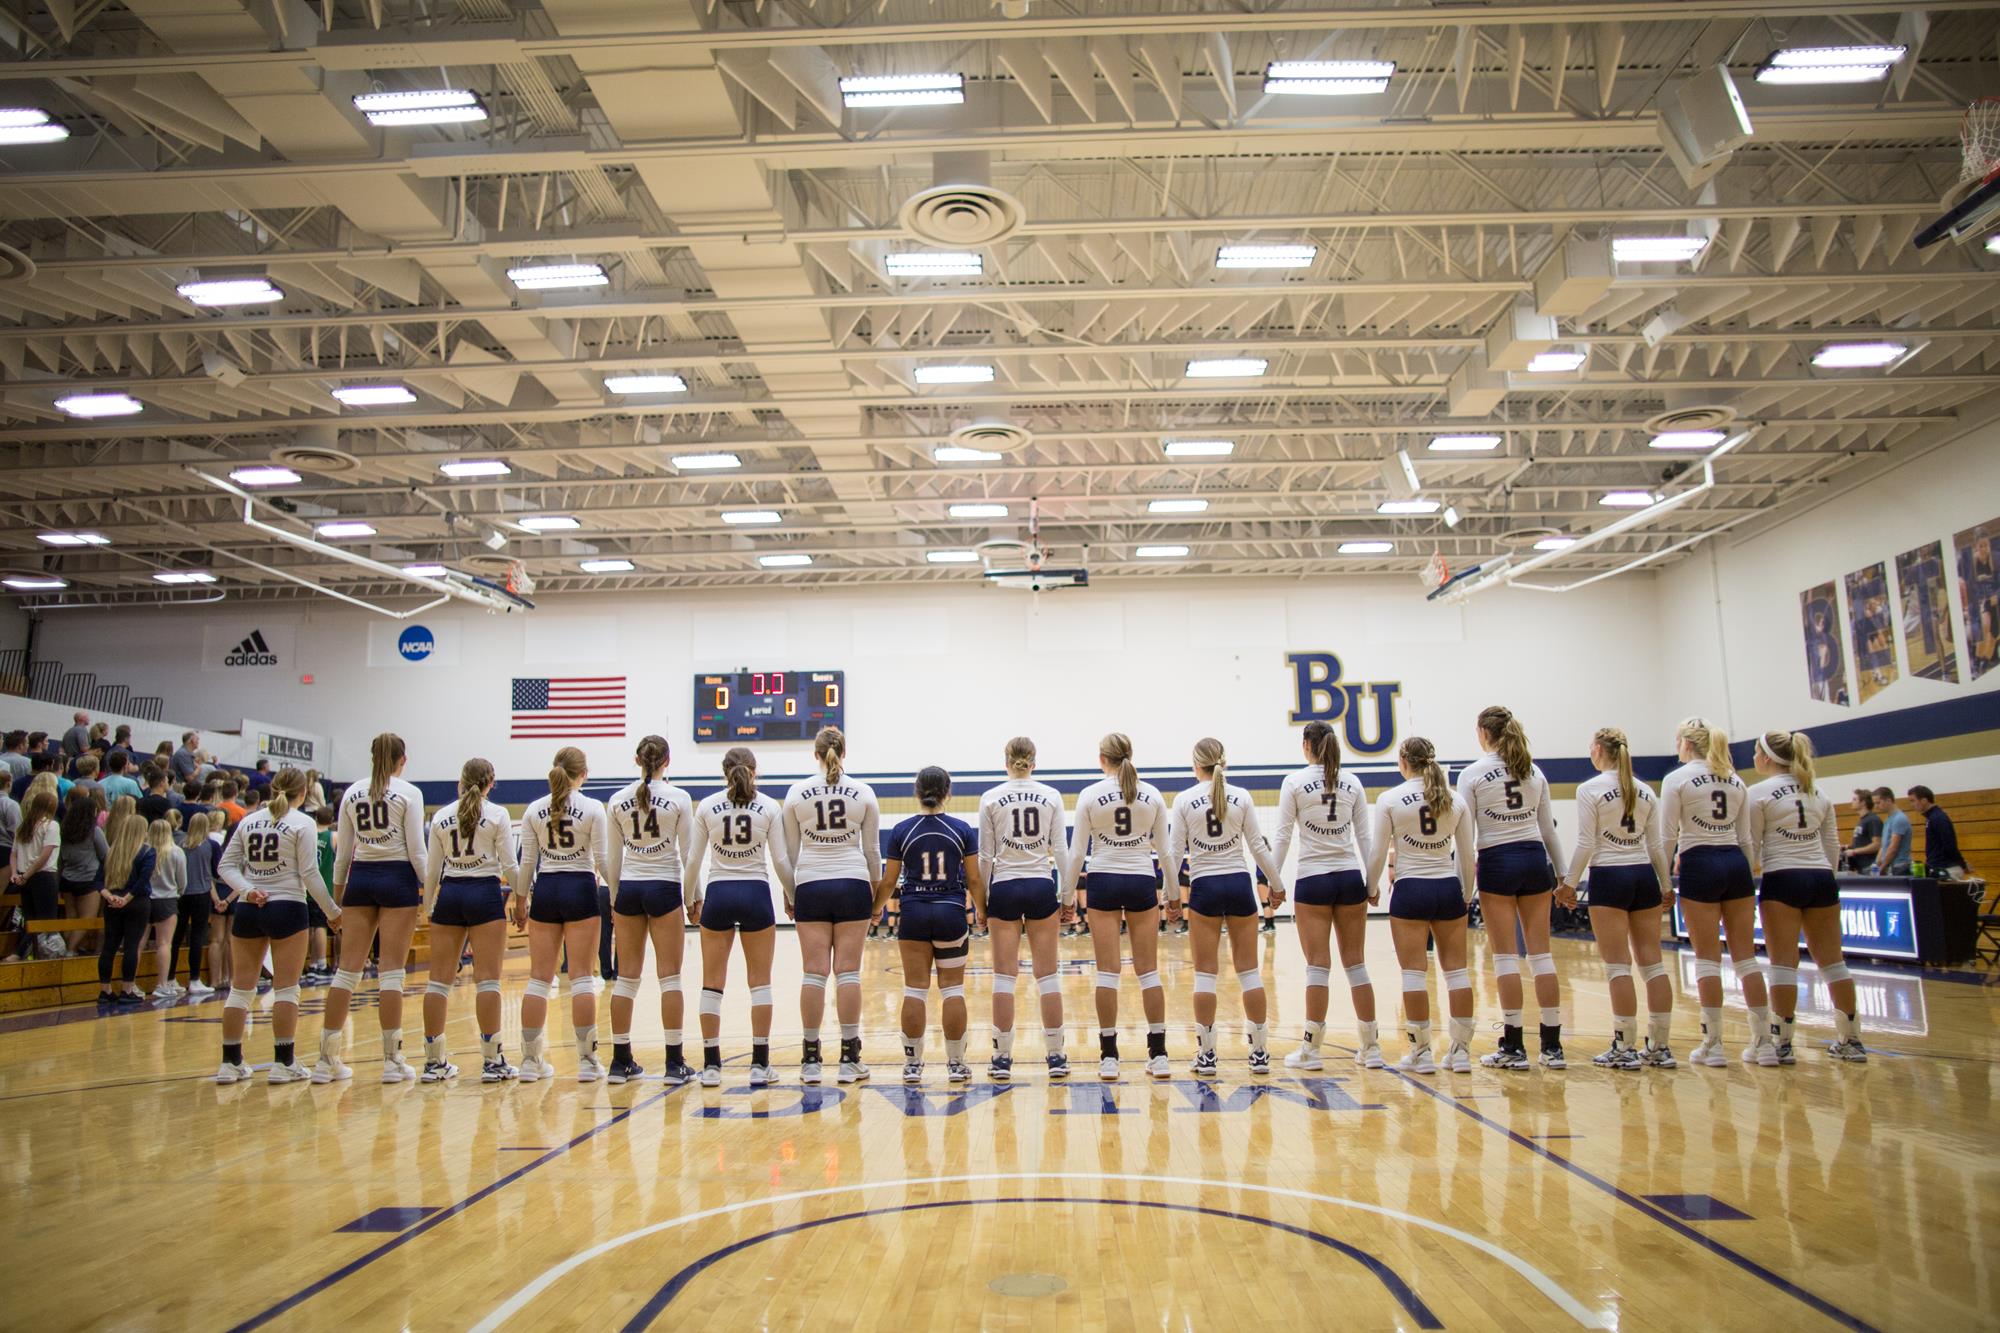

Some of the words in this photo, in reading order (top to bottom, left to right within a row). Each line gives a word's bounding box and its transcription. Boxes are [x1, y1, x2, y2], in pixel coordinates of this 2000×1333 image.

[401, 641, 435, 653] NCAA
[224, 651, 277, 667] adidas
[716, 687, 729, 709] 0
[826, 684, 839, 707] 0
[1284, 650, 1402, 757] BU
[752, 706, 772, 716] period
[785, 698, 796, 716] 0
[350, 789, 397, 804] BEEL
[801, 785, 860, 802] BETHEL
[998, 792, 1048, 807] BETHEL
[1098, 791, 1152, 806] BETEL
[1191, 795, 1240, 810] BEEL
[1504, 779, 1523, 810] 5
[1603, 788, 1649, 802] BEEL
[621, 796, 671, 812] BEHEL
[1321, 793, 1337, 822] 7
[1711, 790, 1728, 820] 3
[1795, 799, 1808, 829] 1
[356, 801, 389, 831] 20
[440, 816, 487, 829] BEL
[631, 808, 660, 840] 14
[814, 799, 847, 831] 12
[1012, 807, 1040, 838] 10
[1114, 806, 1132, 836] 9
[1419, 805, 1438, 836] 6
[1620, 813, 1636, 834] 4
[546, 819, 575, 849] 15
[722, 814, 752, 846] 13
[804, 829, 857, 844] UNIVERSITY
[1305, 819, 1352, 836] UNIVERSITY
[248, 832, 279, 862] 22
[1001, 835, 1046, 851] UNIVERSITY
[1099, 831, 1148, 848] UNIVERSITY
[1192, 833, 1240, 852] UNIVERSITY
[1403, 833, 1452, 850] UNIVERSITY
[713, 842, 763, 859] UNIVERSITY
[920, 851, 947, 881] 11
